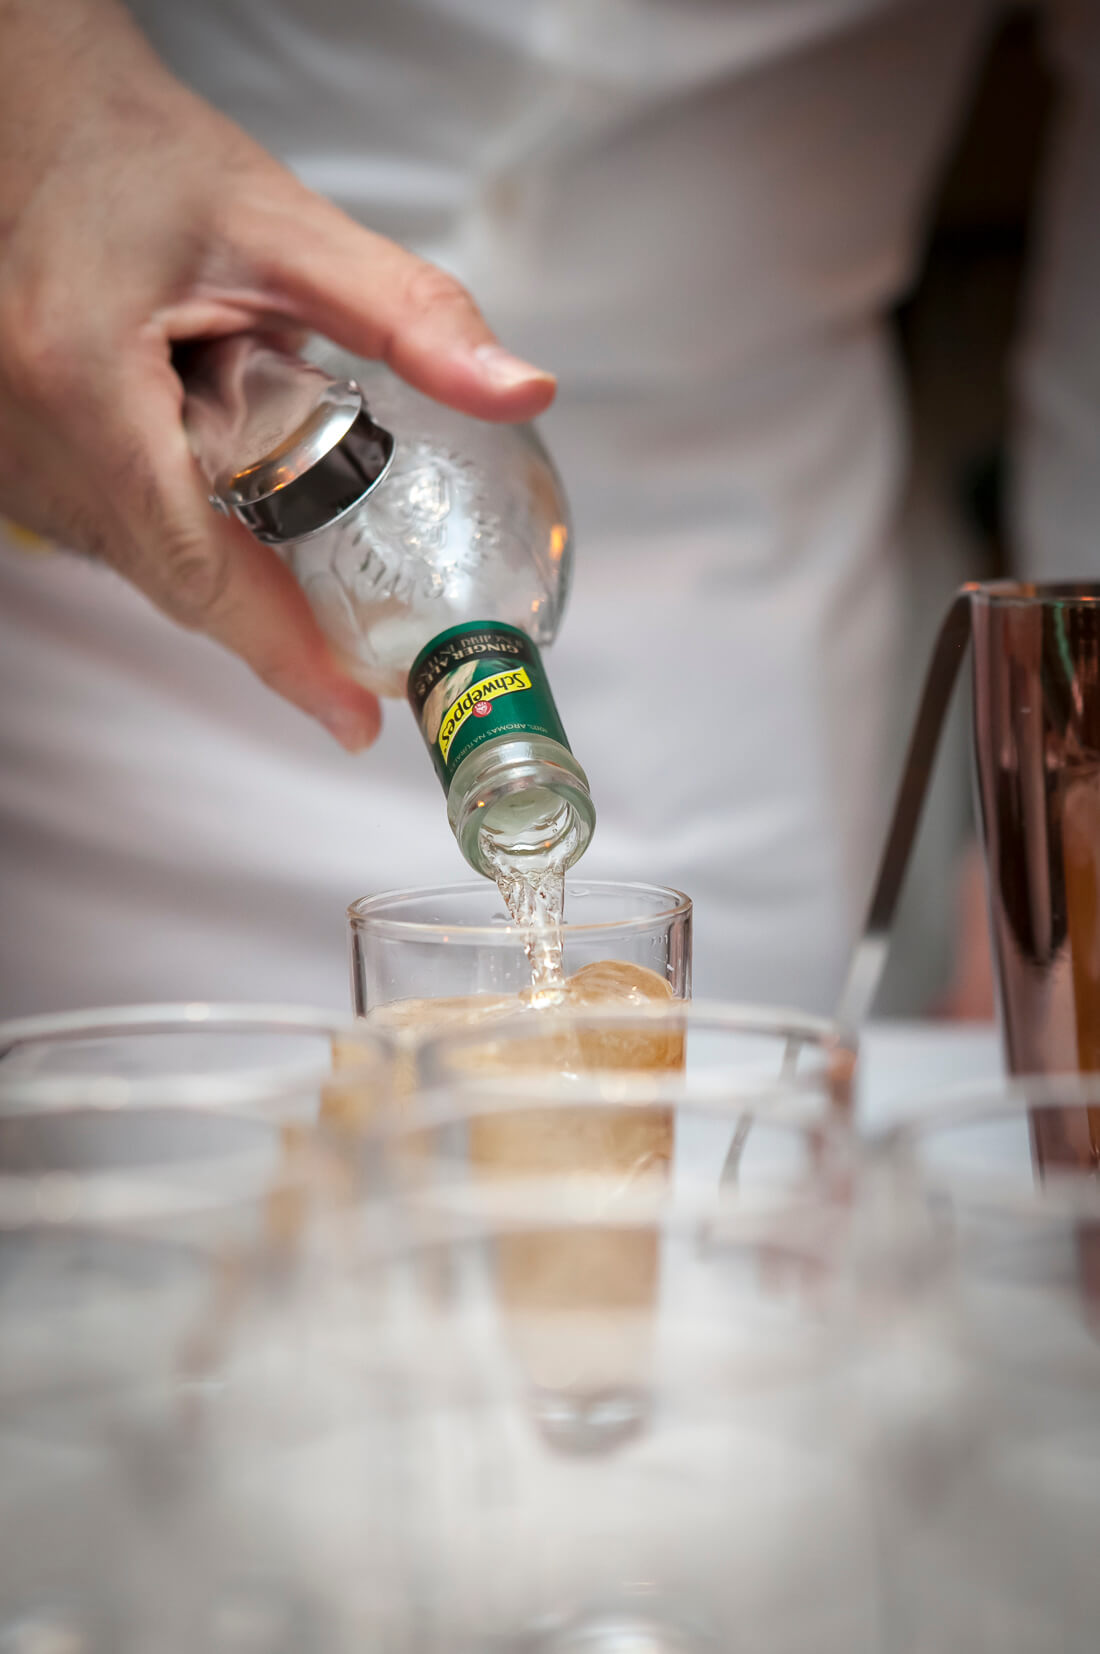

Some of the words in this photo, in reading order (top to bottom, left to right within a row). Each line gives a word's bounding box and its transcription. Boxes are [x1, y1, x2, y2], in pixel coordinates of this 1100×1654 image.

[452, 643, 519, 660] GINGER
[442, 672, 526, 744] Schweppes
[487, 723, 526, 737] AROMAS
